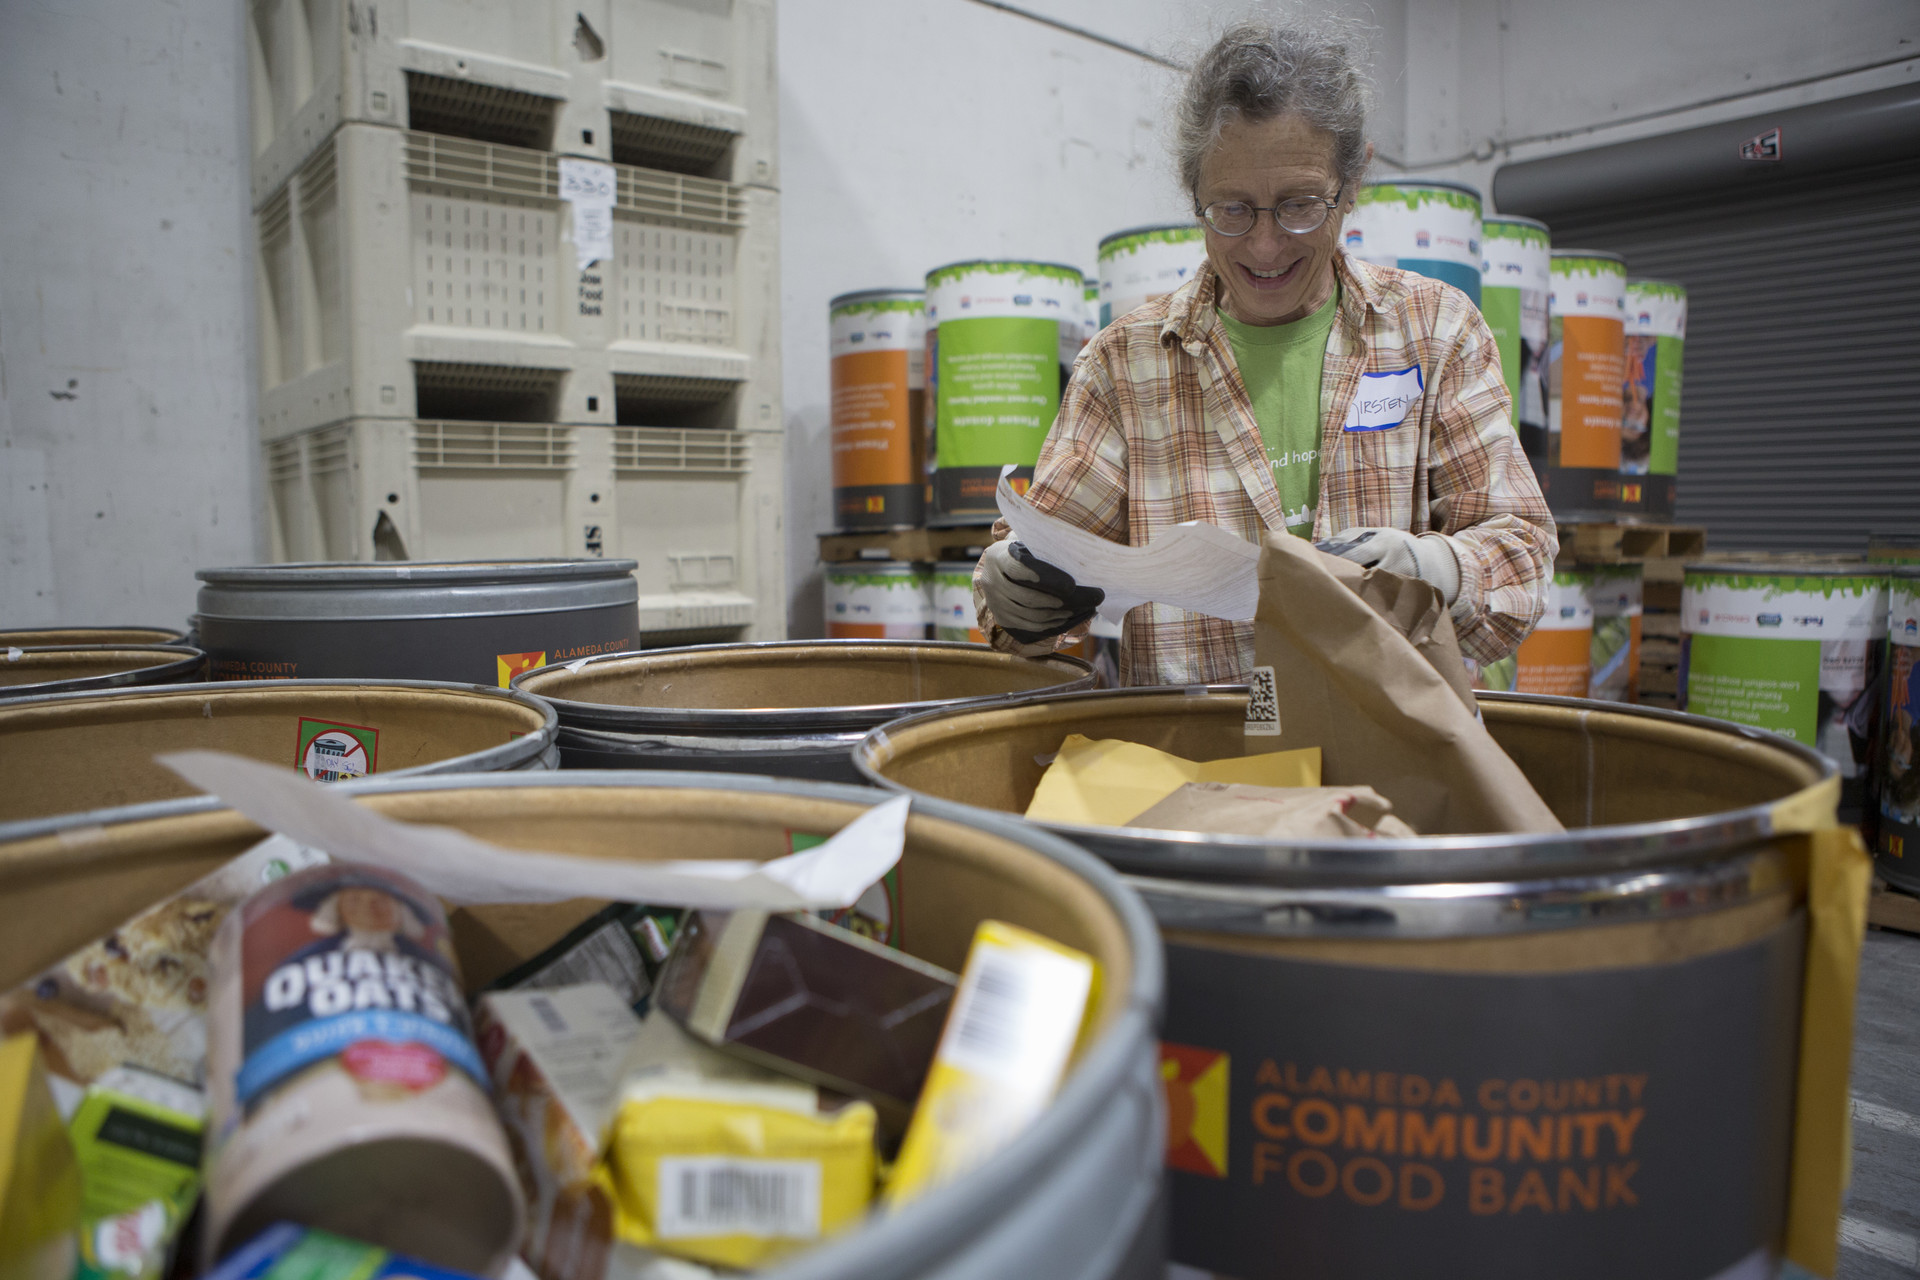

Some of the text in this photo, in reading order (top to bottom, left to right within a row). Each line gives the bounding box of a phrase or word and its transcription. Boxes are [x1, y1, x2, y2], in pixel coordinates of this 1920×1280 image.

[1270, 452, 1288, 468] nd
[250, 661, 298, 674] COUNTY
[554, 643, 603, 660] ALAMEDA
[308, 976, 450, 1025] OATS
[1256, 1057, 1648, 1112] ALAMEDA COUNTY
[1251, 1092, 1646, 1163] COMMUNITY
[1252, 1141, 1640, 1216] FOOD BANK
